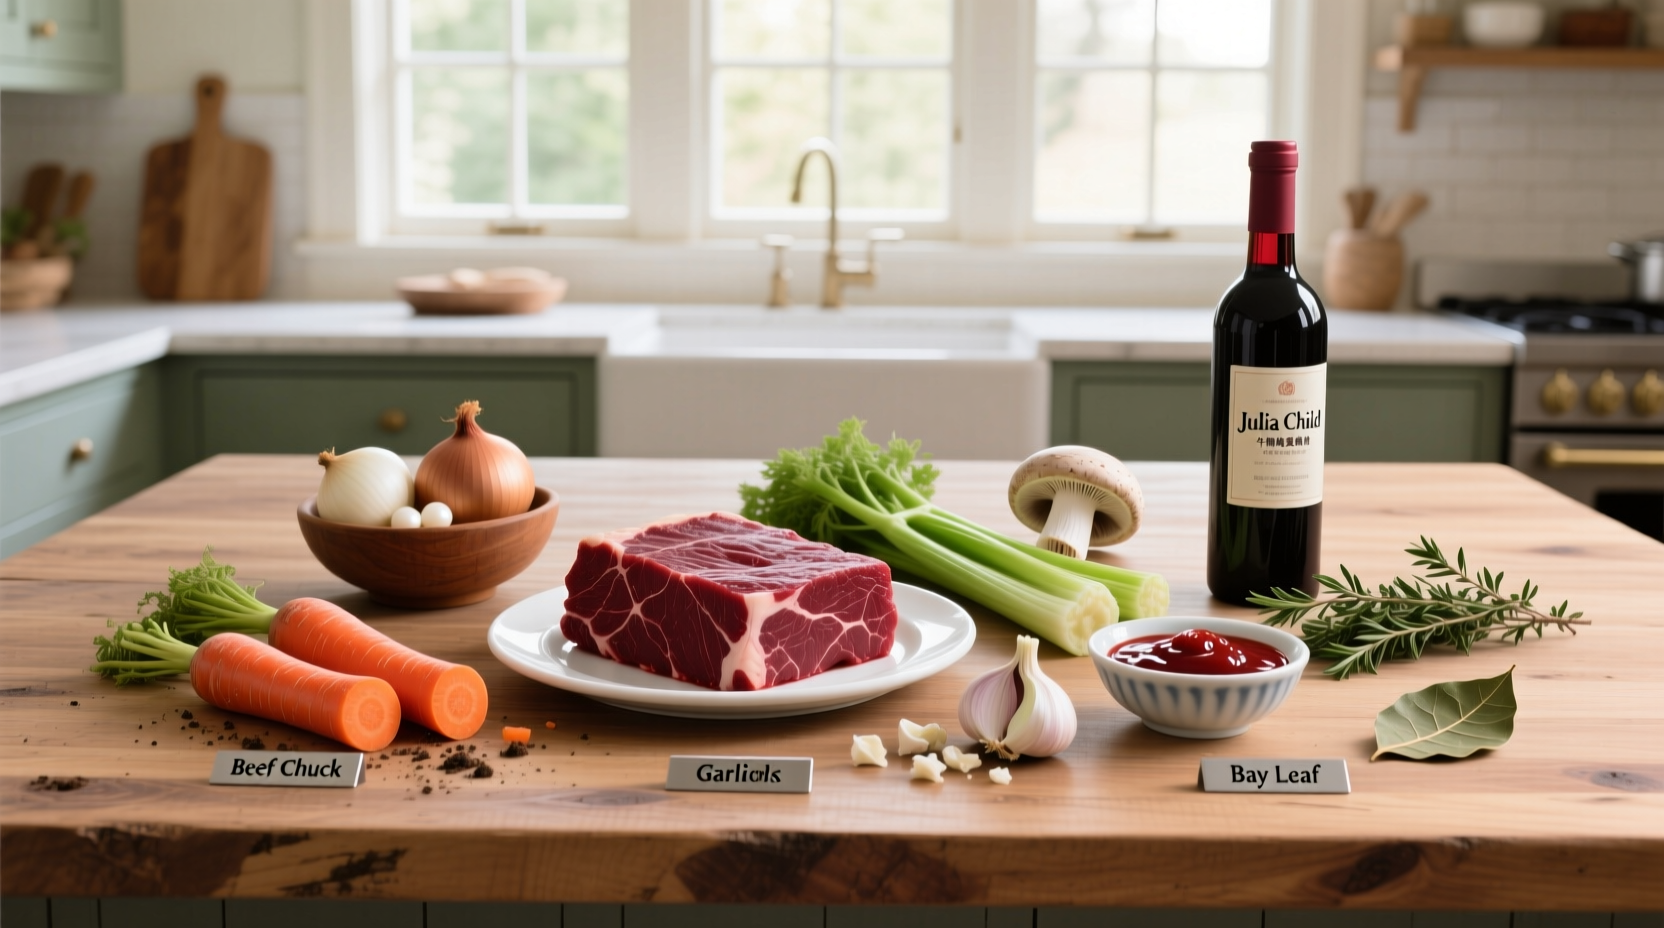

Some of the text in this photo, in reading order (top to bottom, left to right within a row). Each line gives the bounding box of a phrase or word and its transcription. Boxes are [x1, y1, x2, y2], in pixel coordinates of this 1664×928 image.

[1237, 409, 1321, 433] Julia Child
[230, 757, 342, 778] Beef Chuck
[1230, 763, 1321, 789] Bay Leaf
